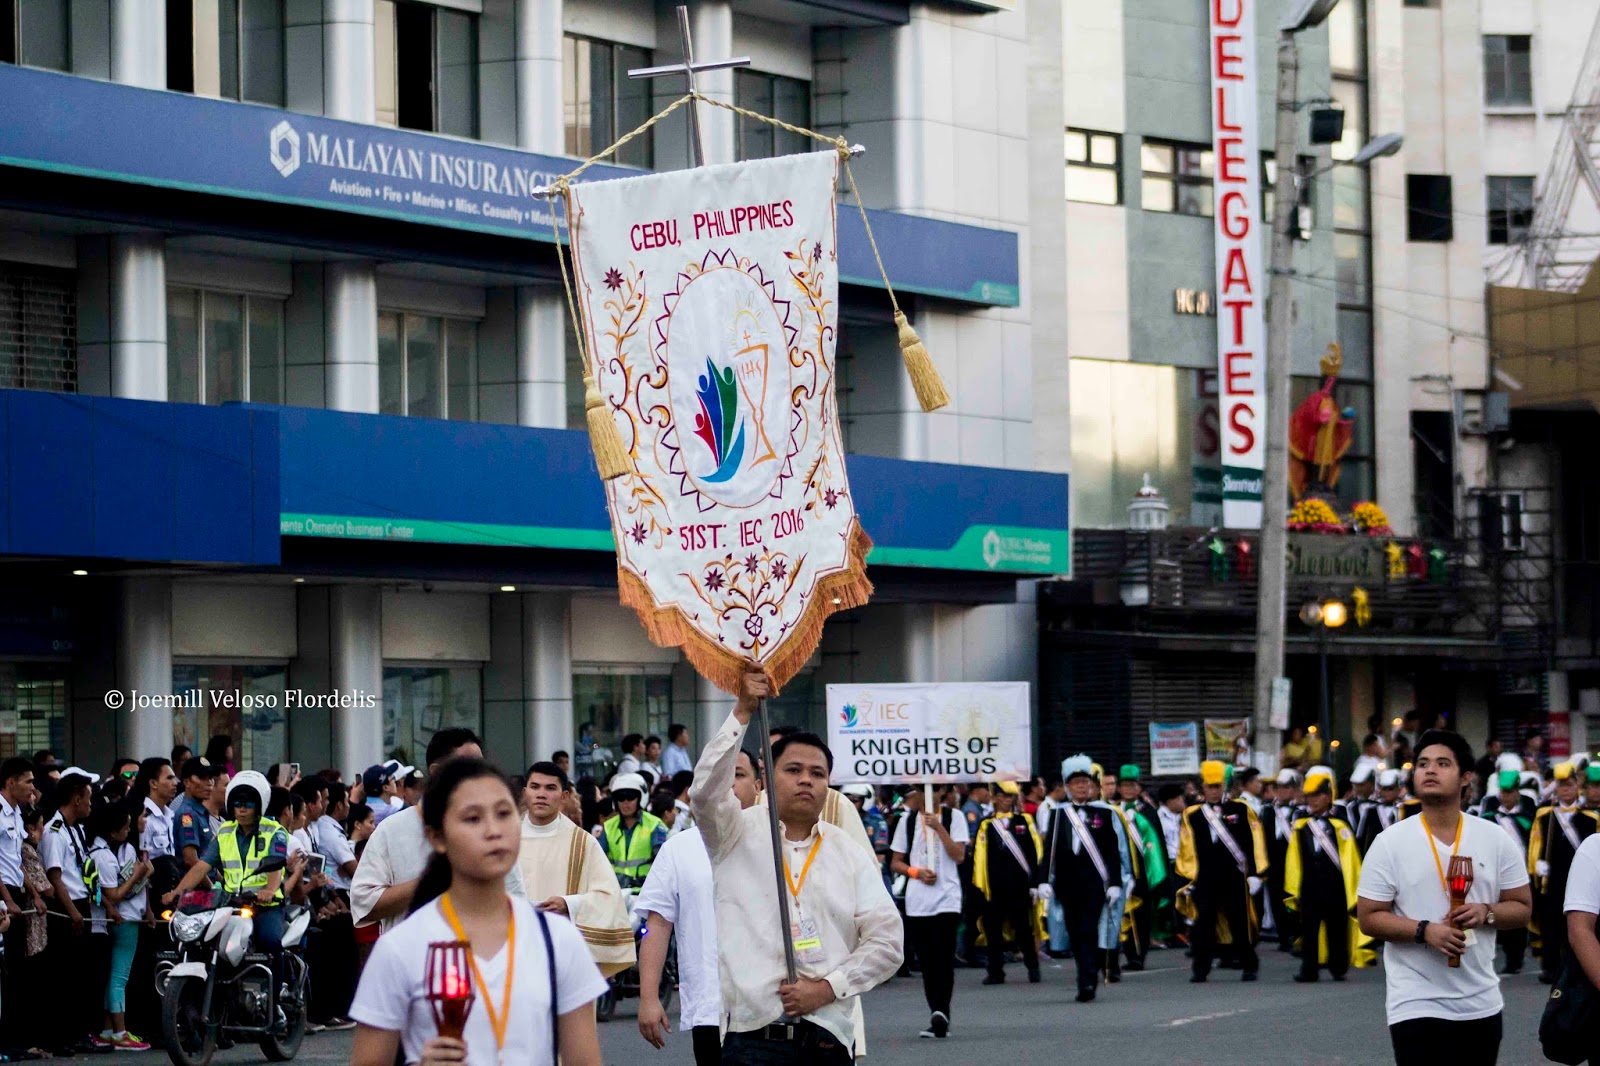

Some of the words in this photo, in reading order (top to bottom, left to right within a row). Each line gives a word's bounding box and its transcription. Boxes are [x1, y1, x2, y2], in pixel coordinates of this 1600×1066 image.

[306, 131, 424, 180] MALAYAN
[329, 178, 372, 199] Aviation
[383, 186, 402, 203] Fire
[412, 191, 446, 210] Marine
[455, 197, 481, 216] Misc.
[482, 202, 523, 225] Casualty
[630, 219, 682, 251] CEBU,
[693, 200, 795, 240] PHILIPPINES
[1212, 0, 1255, 454] DELEGATES
[346, 520, 384, 537] Business
[385, 523, 415, 538] Center
[739, 519, 763, 548] IEC
[771, 508, 805, 539] 2016
[880, 703, 910, 720] IEC
[852, 736, 960, 756] KNIGHTS
[967, 736, 1000, 755] OF
[854, 757, 997, 777] COLUMBUS
